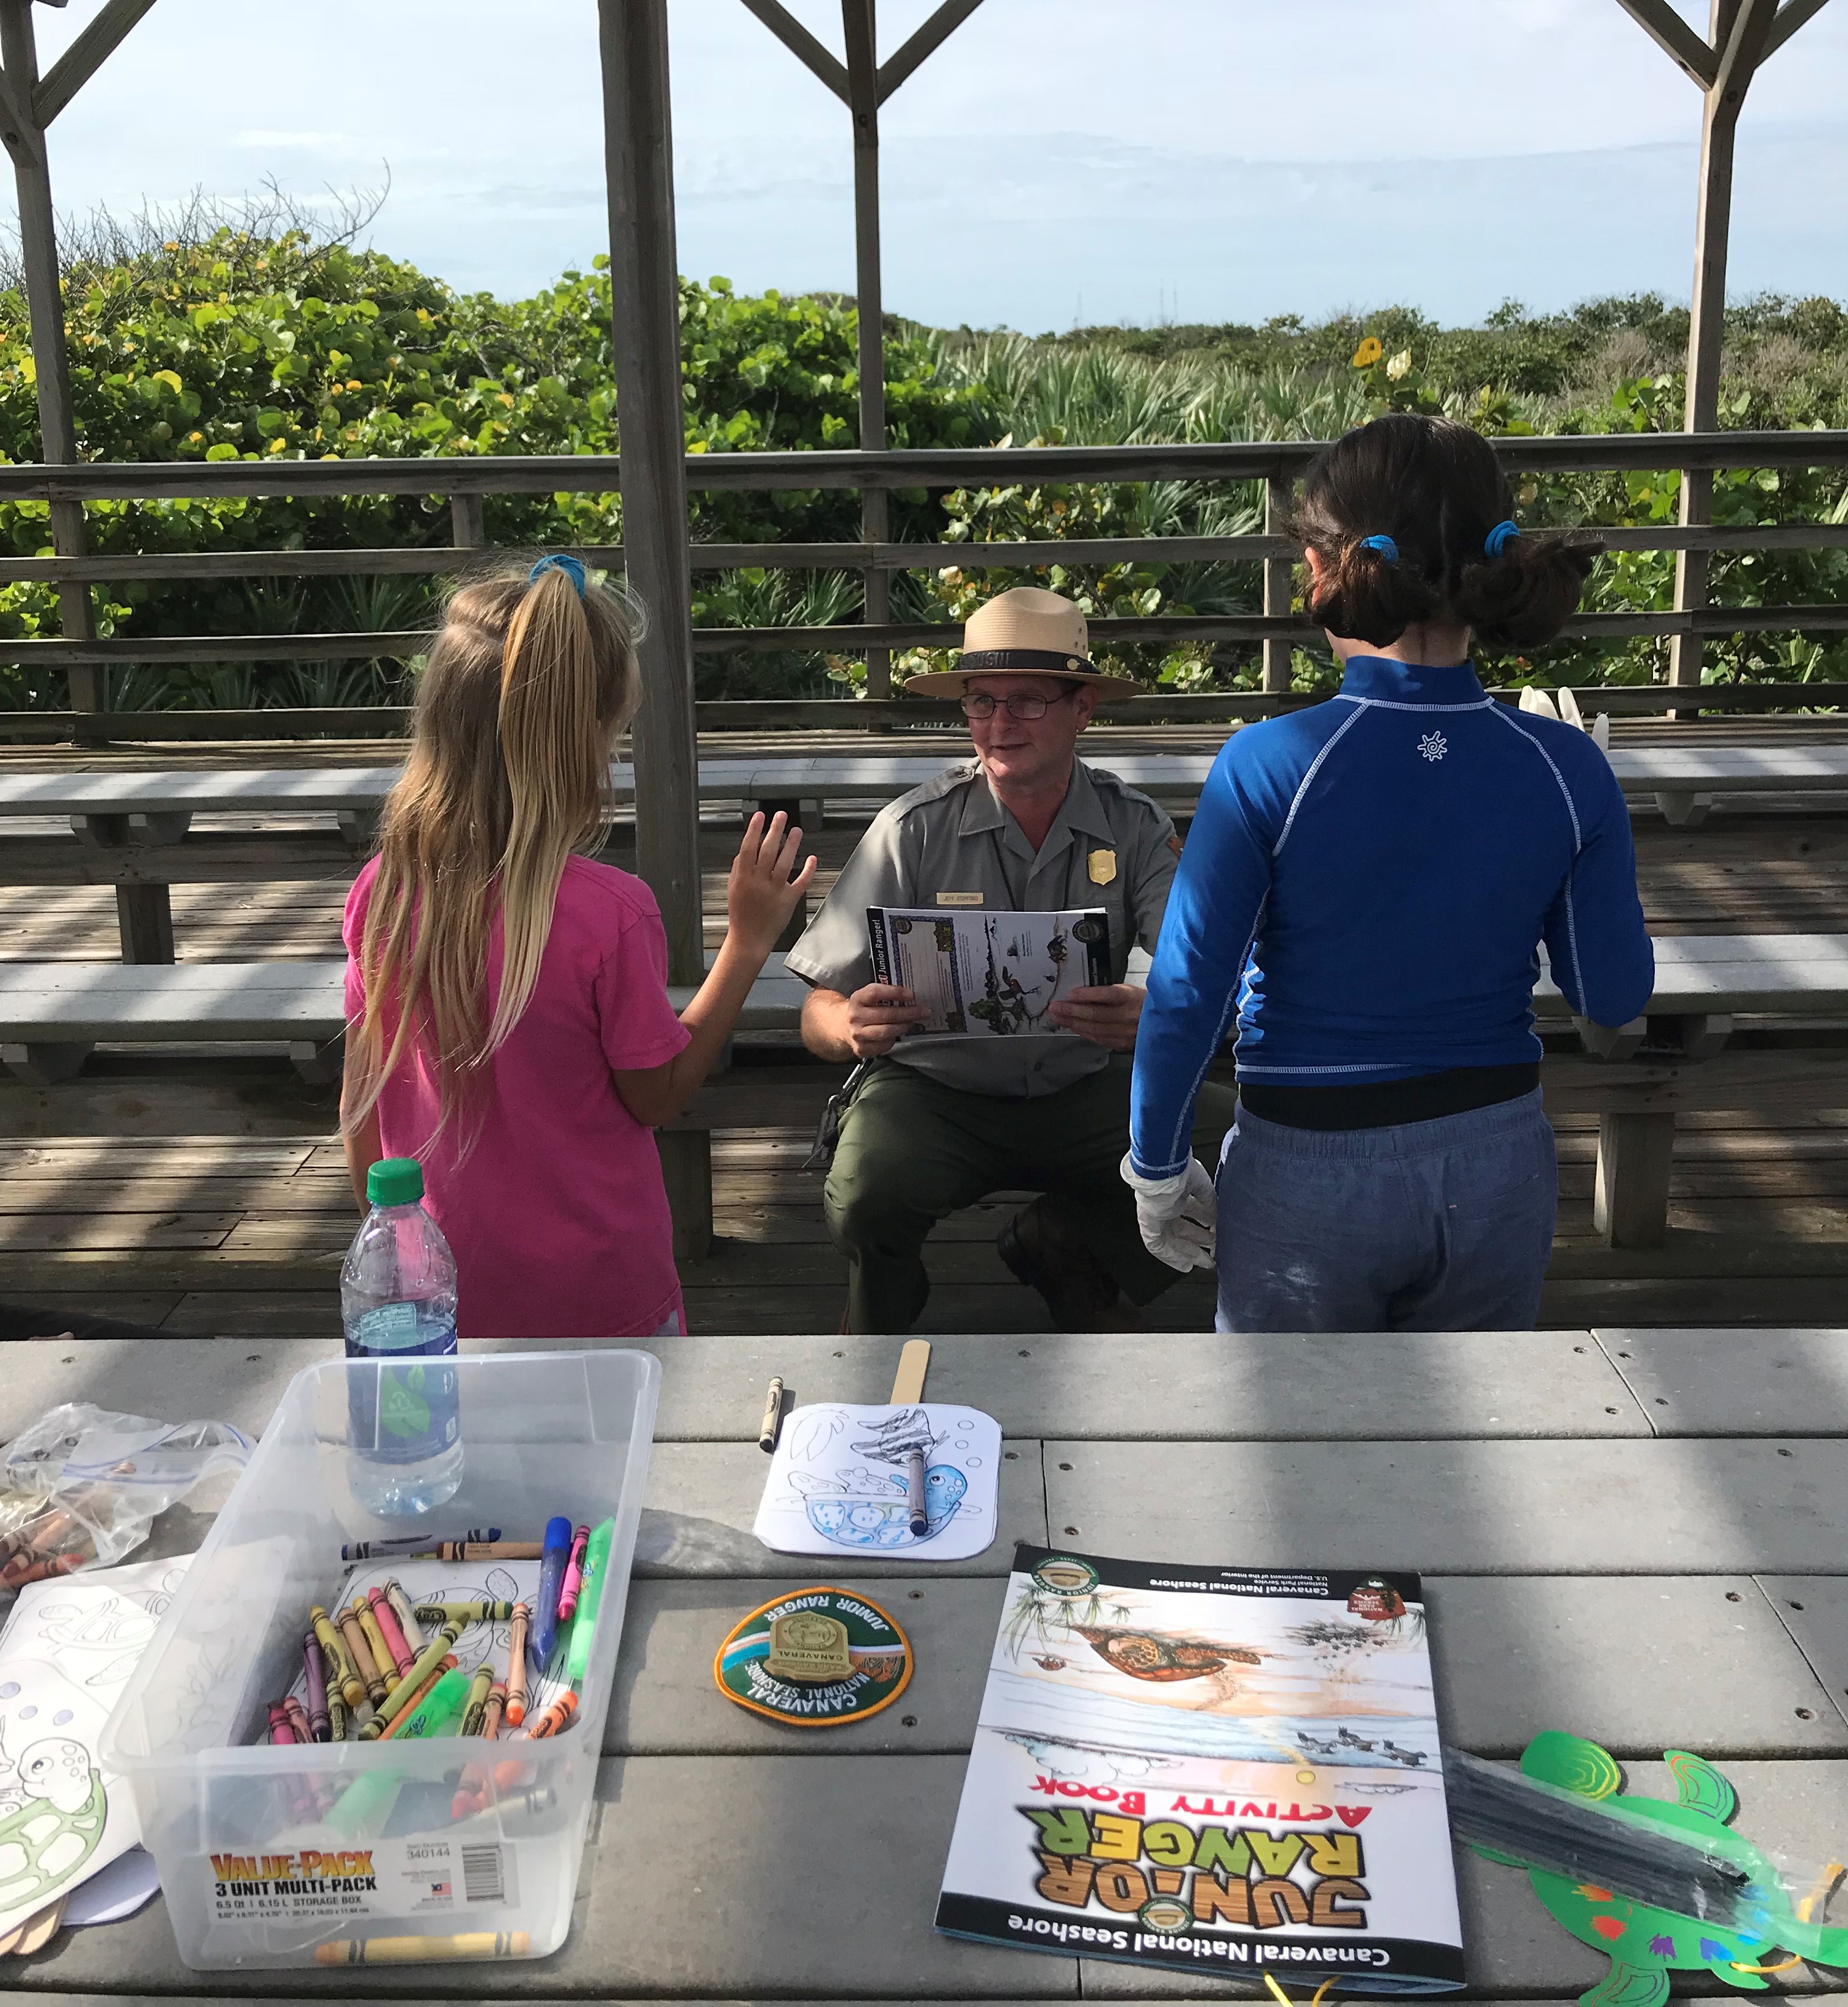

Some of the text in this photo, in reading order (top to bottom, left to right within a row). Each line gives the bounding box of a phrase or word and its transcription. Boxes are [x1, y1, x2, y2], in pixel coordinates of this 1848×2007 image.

[871, 919, 884, 948] Ranger!
[877, 949, 887, 974] Junior
[1034, 1575, 1094, 1595] JUNIOR RANGER
[1150, 1579, 1329, 1595] Canaveral National Seashore
[763, 1596, 889, 1631] JUNIOR RANGER
[777, 1651, 843, 1660] CANAVERAL
[744, 1659, 870, 1699] NATIONAL SEASHORE
[747, 1682, 857, 1712] CANAVERAL
[1014, 1805, 1366, 1878] RANGER
[210, 1849, 375, 1881] VALUE-PACK
[215, 1877, 378, 1896] 3 UNIT MULTI-PACK
[293, 1897, 338, 1907] STORAGE
[342, 1895, 362, 1905] BOX
[1007, 1914, 1390, 1967] Canaveral National Seashore
